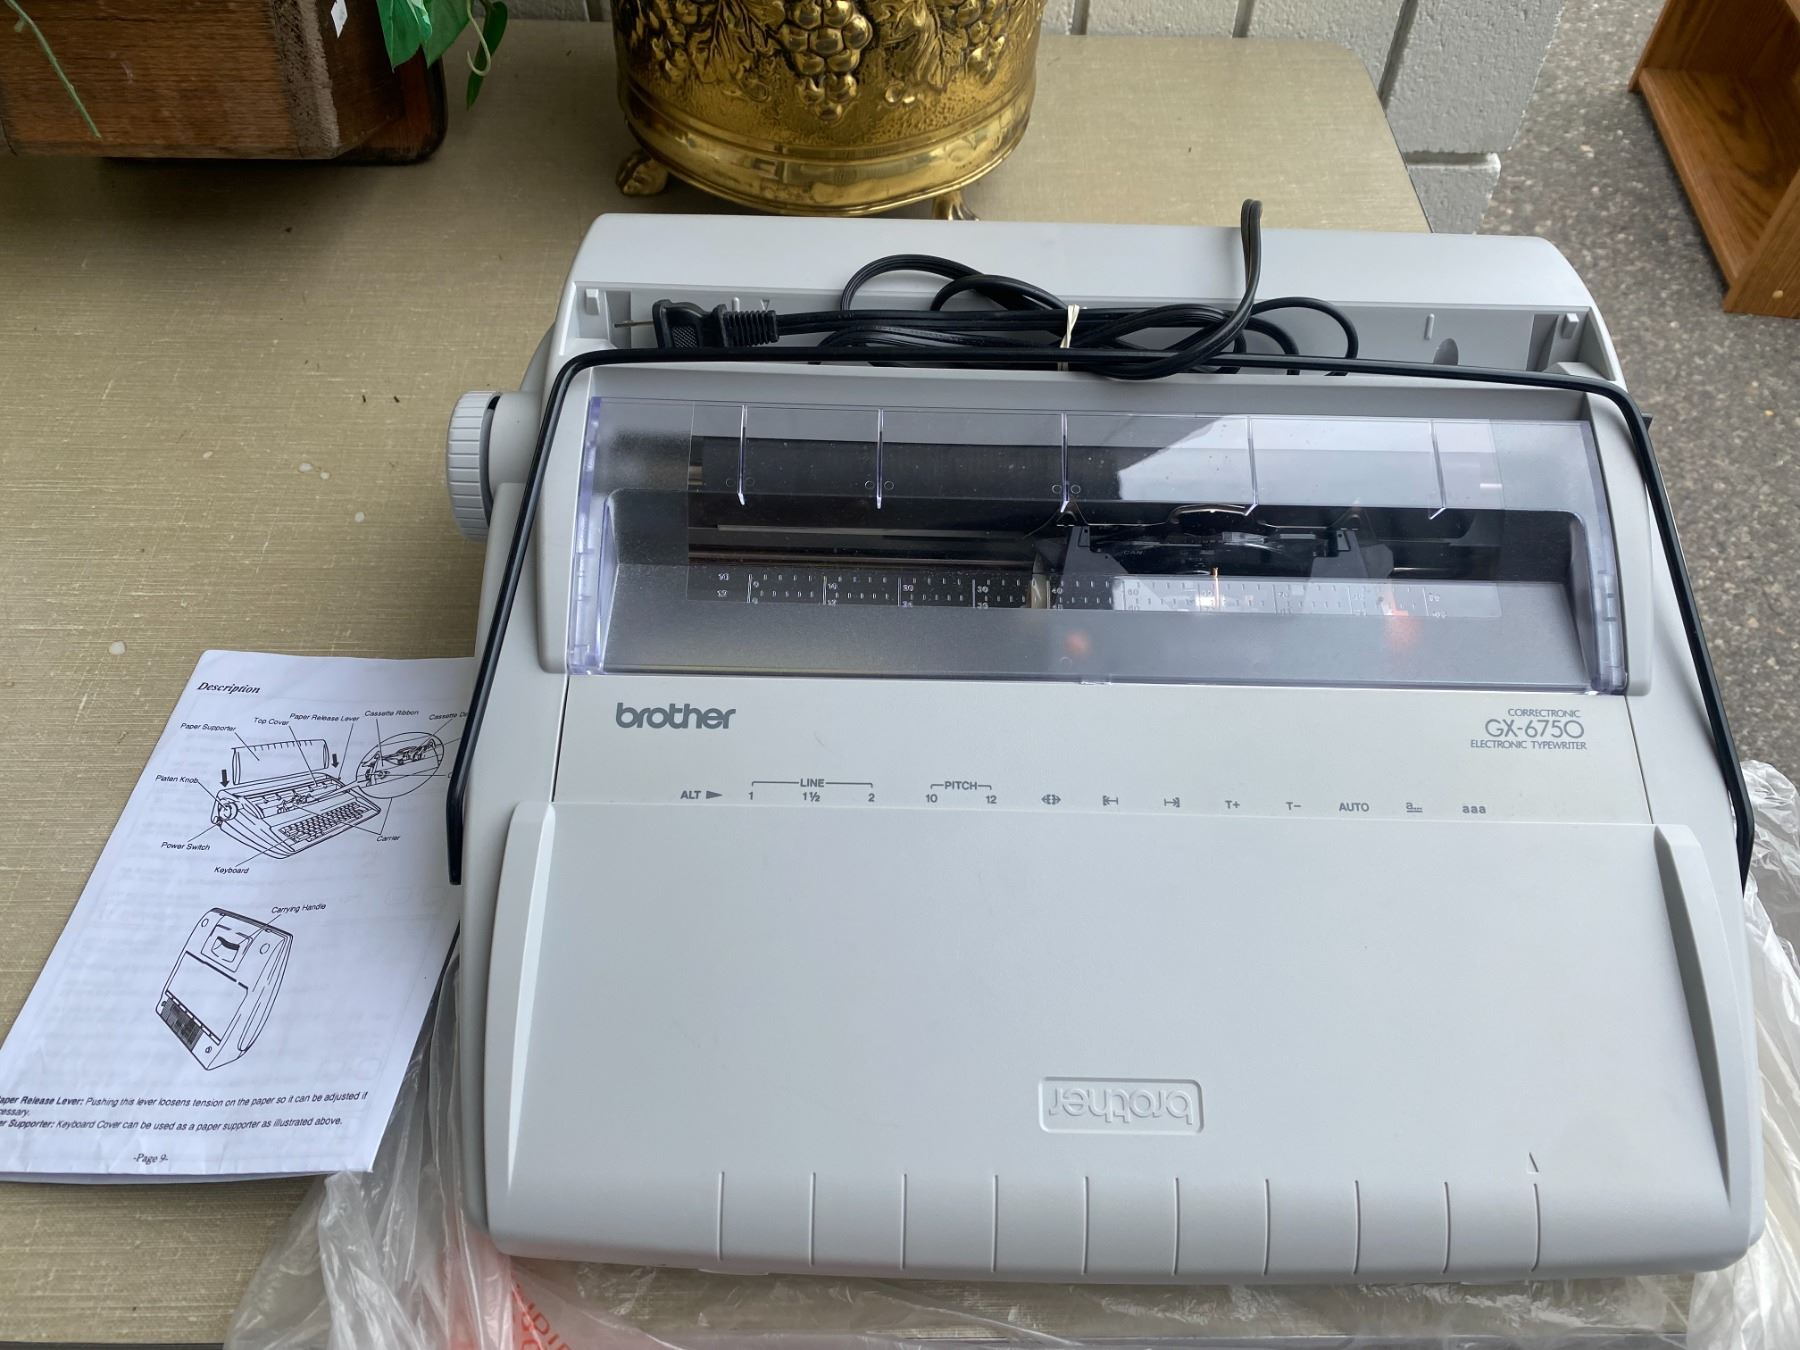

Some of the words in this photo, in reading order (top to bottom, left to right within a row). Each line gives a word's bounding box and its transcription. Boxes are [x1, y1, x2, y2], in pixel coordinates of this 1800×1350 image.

[197, 682, 261, 695] Description
[289, 712, 311, 721] Paper
[311, 713, 339, 722] Release
[615, 702, 737, 730] brother
[1507, 708, 1582, 718] CORRECTRONIC
[253, 717, 267, 725] Top
[268, 718, 290, 726] Cover
[180, 722, 201, 730] Paper
[202, 723, 237, 732] Supporter
[1485, 718, 1585, 739] GX-6750
[1470, 739, 1528, 749] ELECTRONIC
[1530, 740, 1588, 750] TYPEWRITER
[155, 774, 179, 782] Platen
[179, 775, 199, 784] Knob
[800, 778, 825, 788] LINE
[944, 781, 978, 790] PITCH
[680, 790, 702, 800] ALT
[748, 792, 754, 801] 1
[868, 793, 876, 802] 2
[925, 793, 938, 803] 10
[985, 794, 998, 804] 12
[1225, 800, 1241, 810] T+
[1338, 802, 1370, 813] AUTO
[1462, 805, 1487, 815] aaa
[160, 841, 185, 850] Power
[186, 842, 211, 851] Switch
[214, 866, 250, 875] Keyboard
[271, 905, 300, 914] Carrying
[302, 903, 327, 911] Handle
[20, 1096, 55, 1105] Release
[56, 1096, 84, 1105] Lever:
[85, 1097, 120, 1107] Pushing
[120, 1098, 135, 1106] this
[136, 1098, 157, 1106] lever
[158, 1098, 191, 1107] loosens
[192, 1099, 223, 1108] tension
[225, 1099, 236, 1107] on
[237, 1098, 250, 1106] the
[250, 1096, 276, 1107] paper
[276, 1096, 287, 1104] so
[288, 1095, 294, 1103] it
[295, 1094, 310, 1103] can
[312, 1093, 323, 1102] be
[324, 1091, 360, 1103] adjusted
[361, 1090, 368, 1100] if
[1049, 1087, 1195, 1126] brother
[8, 1119, 55, 1130] Supporter:
[56, 1120, 96, 1130] Keyboard
[96, 1120, 122, 1129] Cover
[122, 1121, 139, 1129] can
[140, 1121, 152, 1130] be
[153, 1121, 176, 1131] used
[176, 1123, 187, 1131] as
[195, 1123, 222, 1132] paper
[222, 1120, 260, 1131] supporter
[261, 1120, 272, 1128] as
[273, 1118, 313, 1128] illustrated
[314, 1117, 343, 1126] above.
[133, 1153, 159, 1166] -Page
